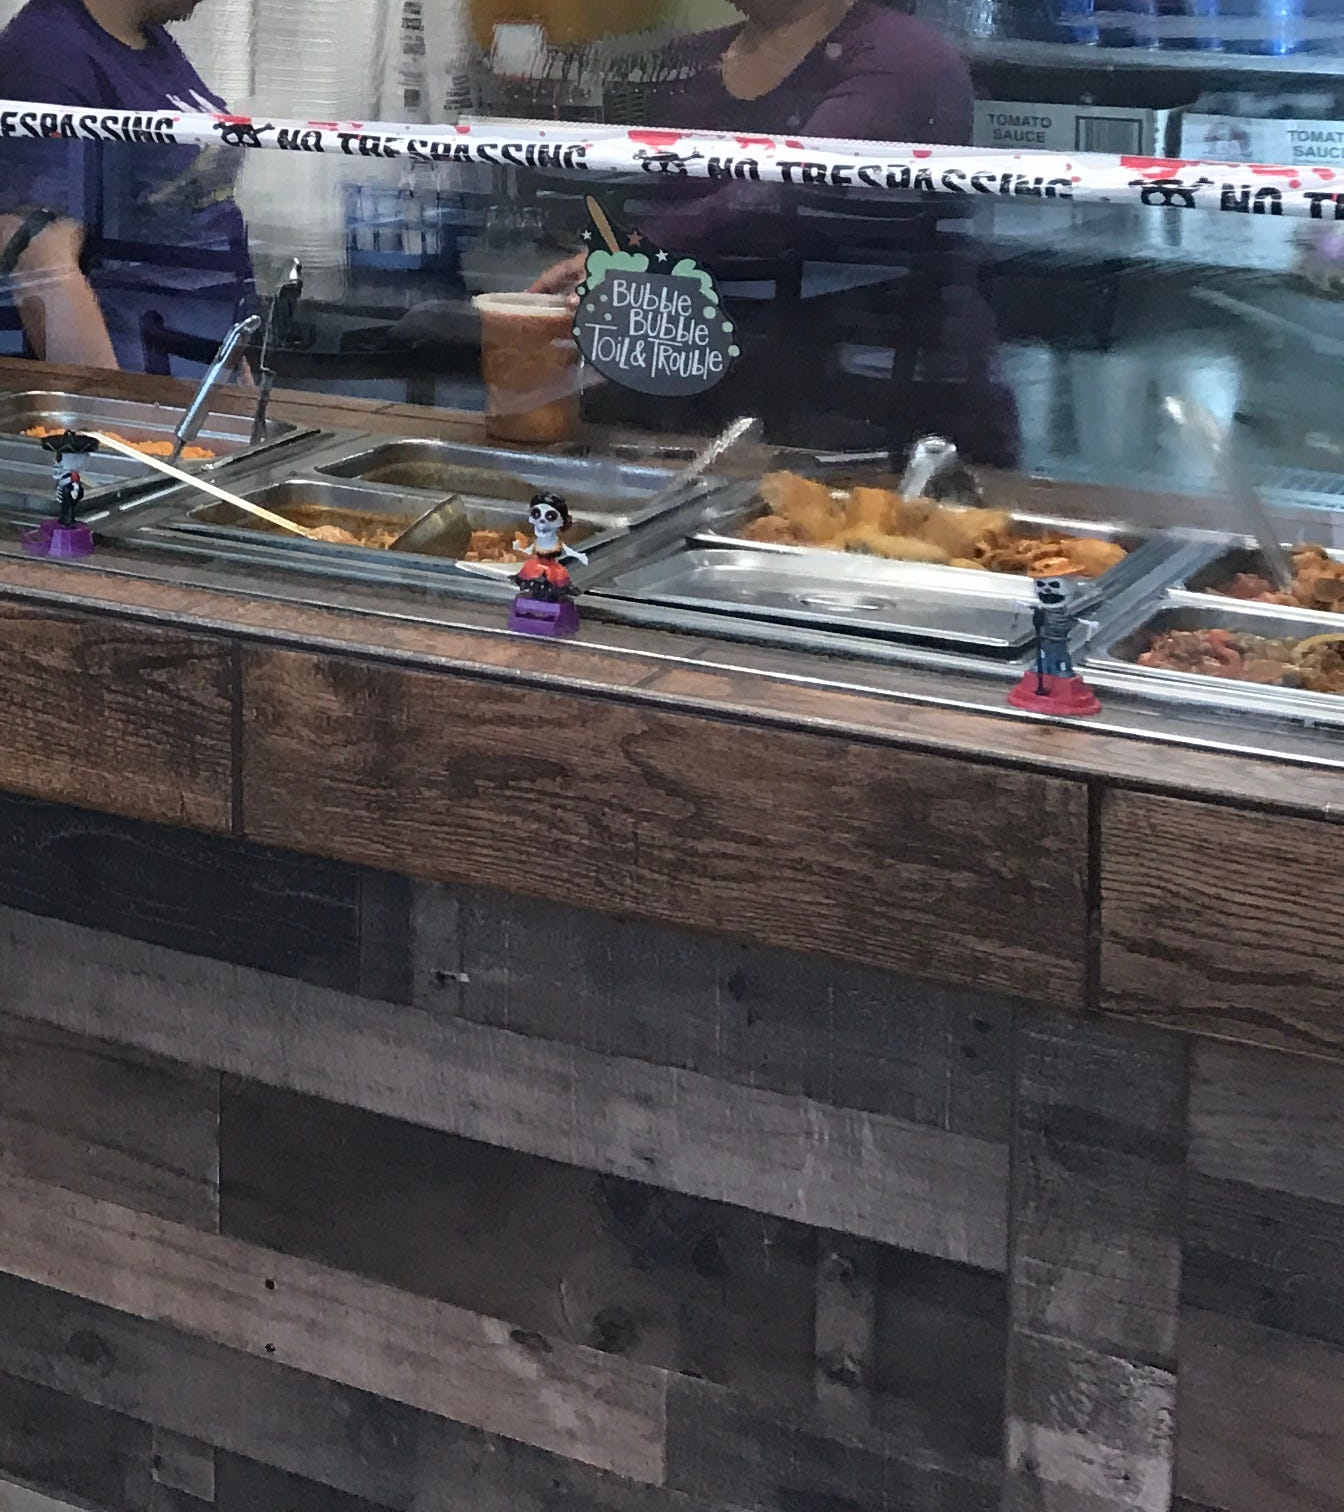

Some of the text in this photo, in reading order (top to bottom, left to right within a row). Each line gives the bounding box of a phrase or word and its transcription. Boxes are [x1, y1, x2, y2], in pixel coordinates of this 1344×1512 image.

[986, 112, 1053, 129] TOMATO
[992, 128, 1046, 144] SAUCE
[1287, 129, 1344, 144] TOMAT
[1293, 144, 1344, 159] SAUC
